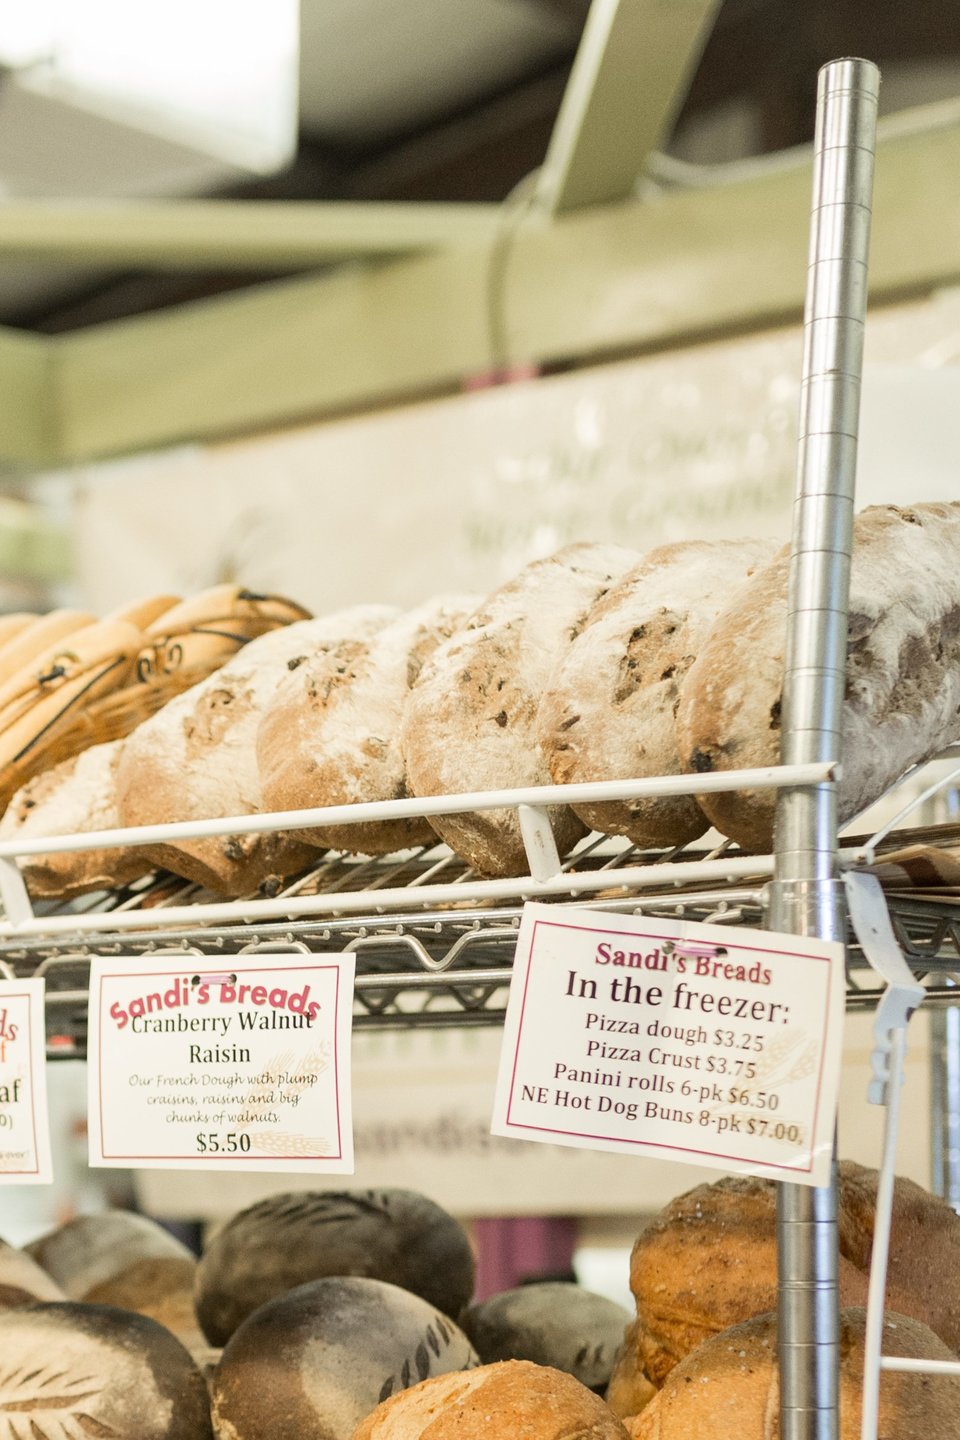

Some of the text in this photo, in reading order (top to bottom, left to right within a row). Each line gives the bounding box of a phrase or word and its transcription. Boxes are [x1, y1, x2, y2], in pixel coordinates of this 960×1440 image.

[595, 942, 772, 986] Sandi's Breads
[110, 977, 321, 1029] Sandi's Breads
[565, 971, 790, 1024] In the freezer:
[131, 1010, 314, 1036] Cranberry Walnut
[585, 1013, 764, 1052] Pizza dough $3.25
[189, 1044, 251, 1064] Raisin
[587, 1040, 756, 1079] Pizza Crust $3.75
[128, 1072, 318, 1090] Our French Dough with plump
[147, 1092, 300, 1107] craisins, raisins and big
[554, 1063, 778, 1111] Panini rolls 6-pk $6.50
[166, 1110, 281, 1127] chunks of walnuts.
[521, 1085, 549, 1104] NE
[554, 1090, 590, 1110] Hot
[598, 1096, 638, 1121] Dog
[645, 1102, 693, 1124] Buns
[699, 1110, 740, 1135] 8-pk
[196, 1132, 251, 1153] $5.50
